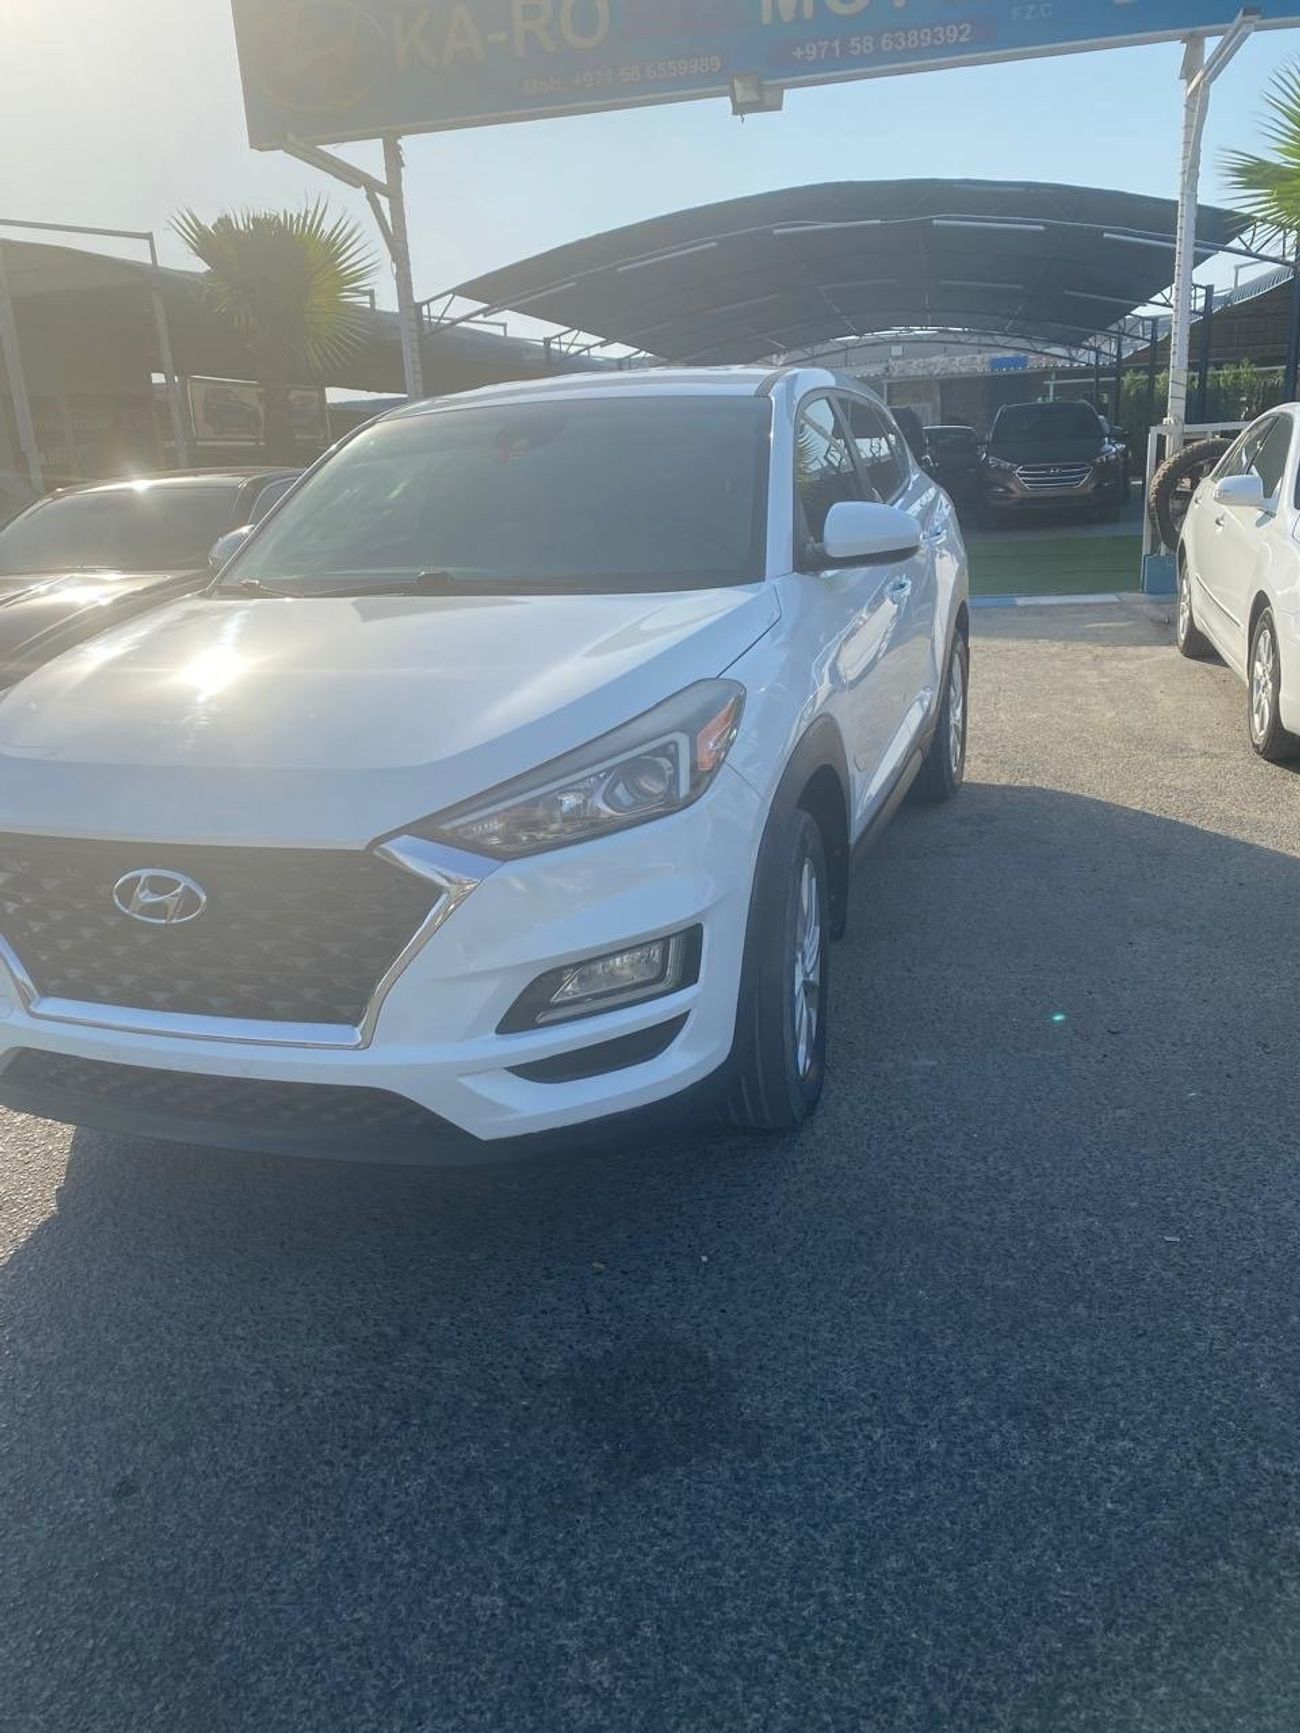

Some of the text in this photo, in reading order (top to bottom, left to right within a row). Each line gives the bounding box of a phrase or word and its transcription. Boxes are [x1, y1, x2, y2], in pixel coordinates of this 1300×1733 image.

[391, 0, 610, 71] KA-RO
[792, 23, 972, 61] +971 58 6389392
[619, 65, 640, 83] 58
